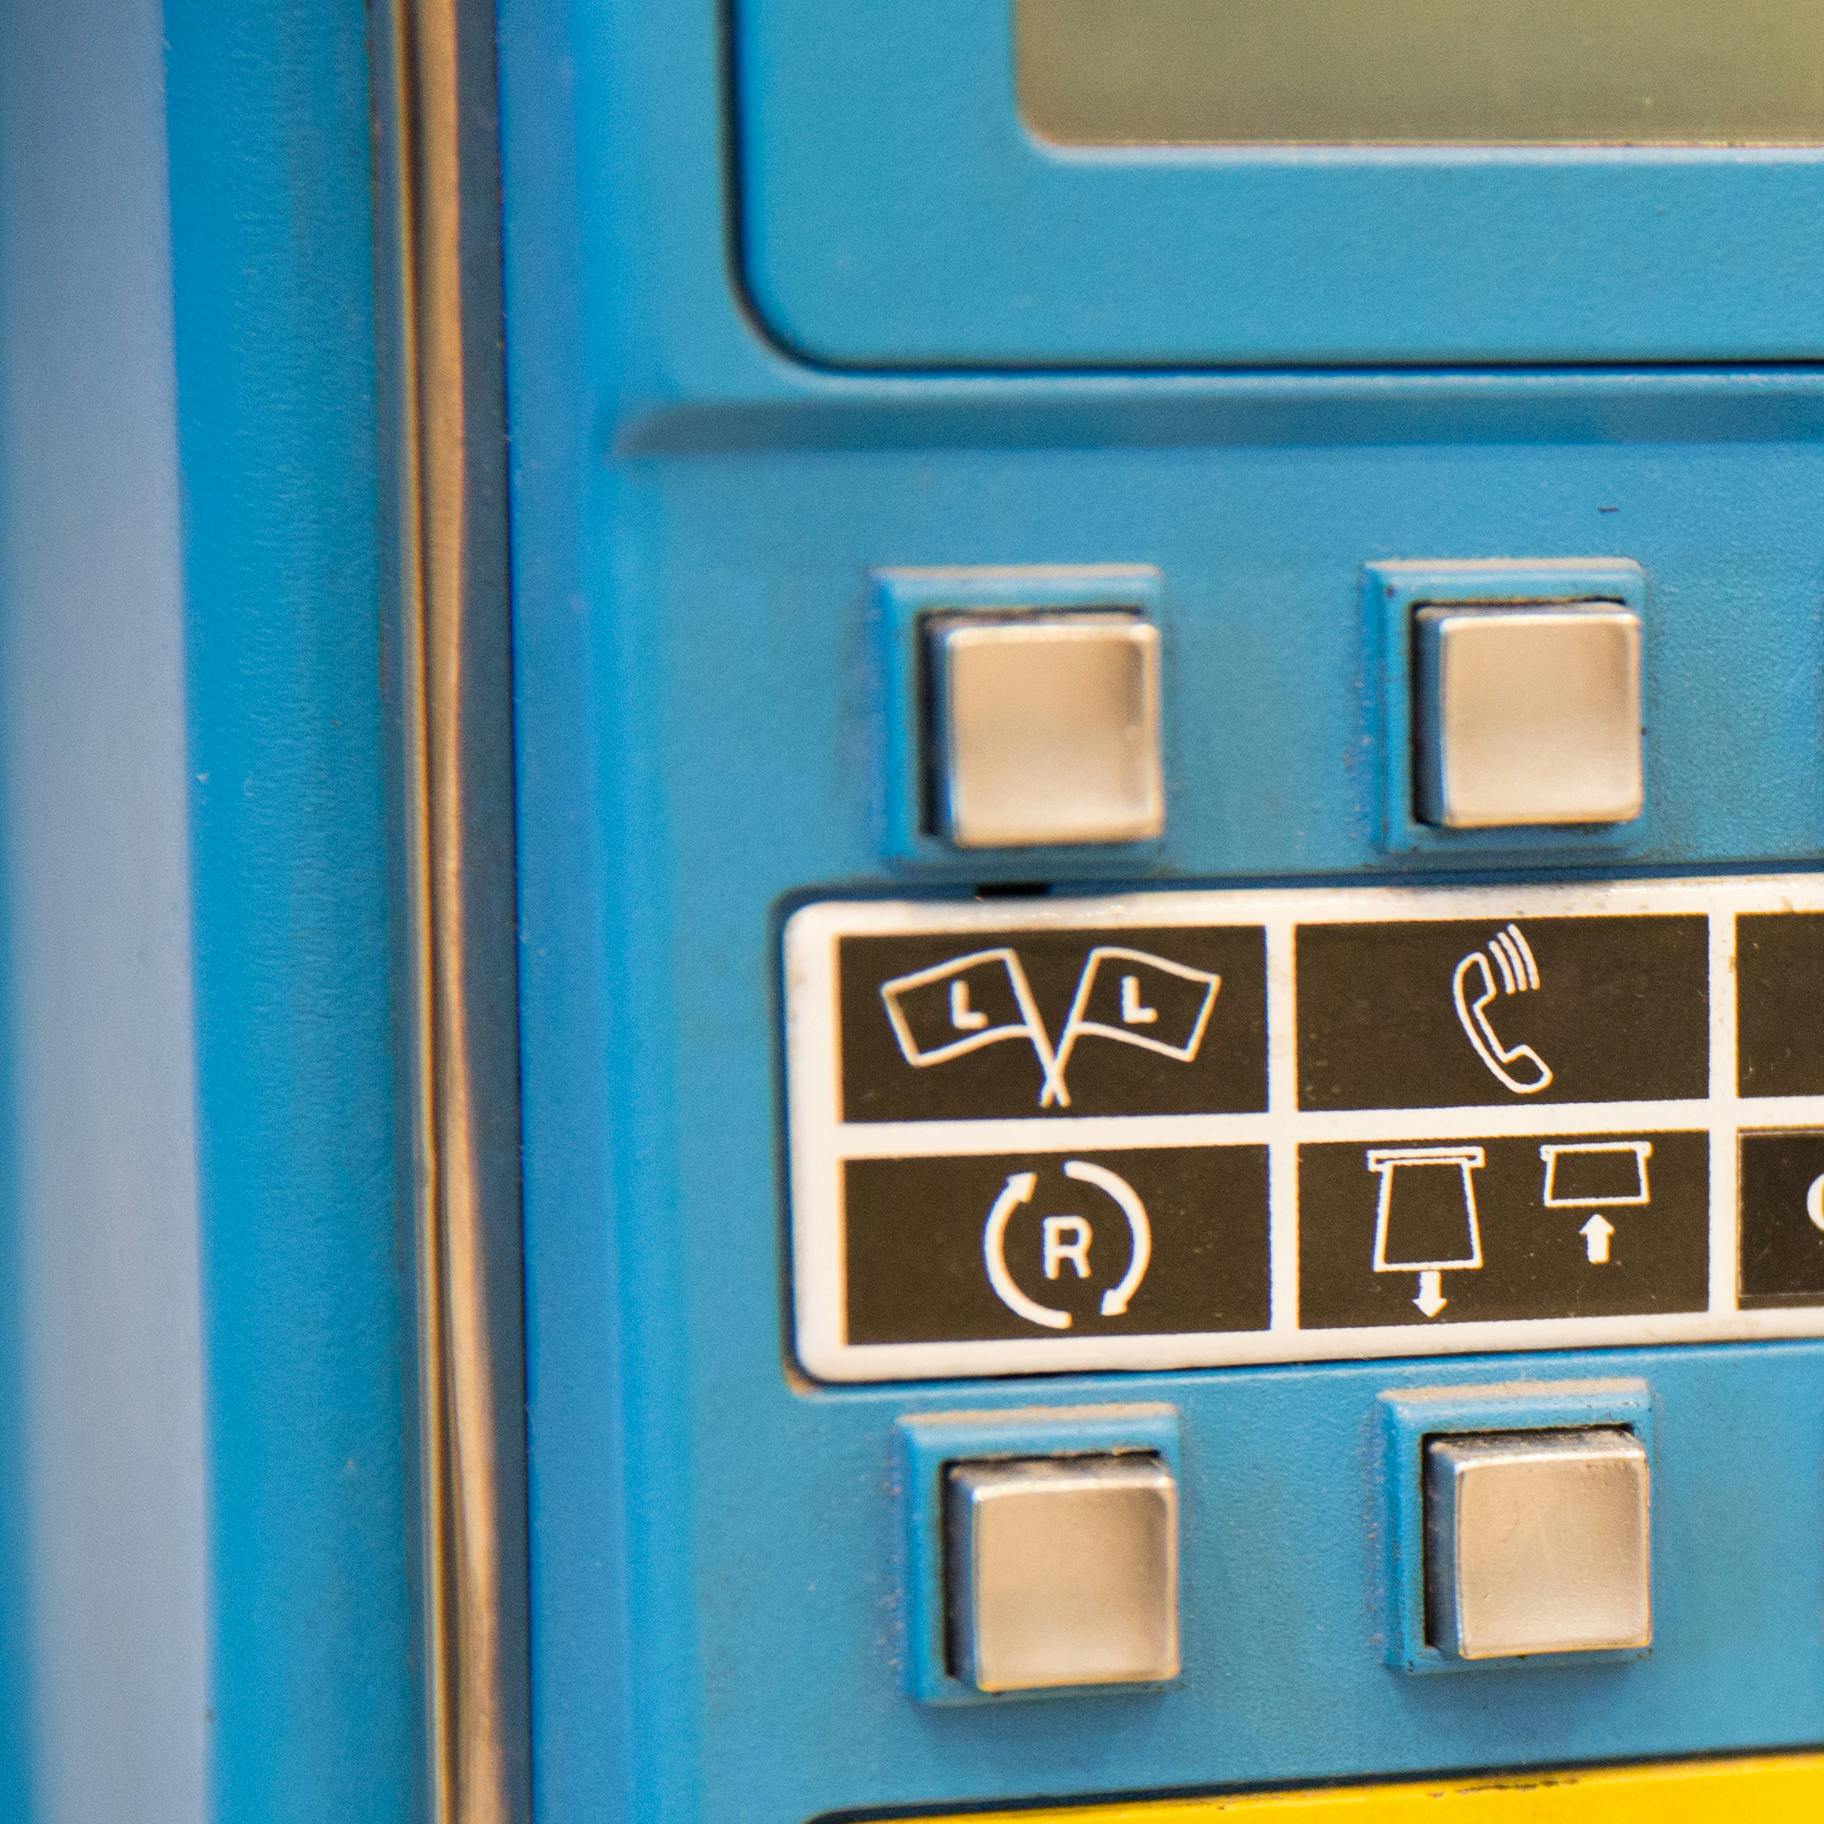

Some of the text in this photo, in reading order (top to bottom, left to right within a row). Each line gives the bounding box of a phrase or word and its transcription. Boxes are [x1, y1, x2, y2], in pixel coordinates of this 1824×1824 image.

[950, 979, 989, 1030] L
[1122, 974, 1159, 1024] L
[1042, 1214, 1095, 1281] R
